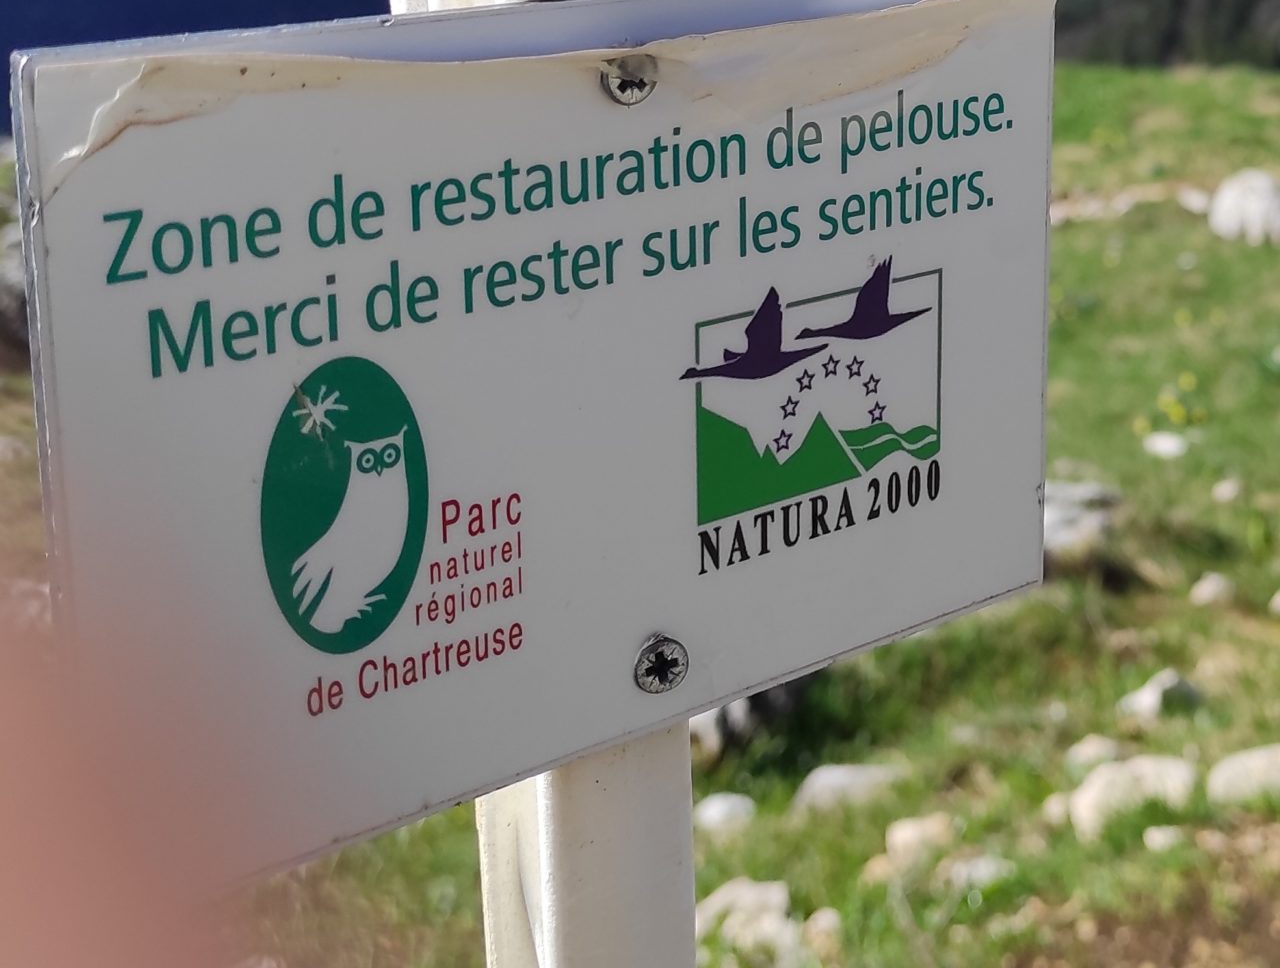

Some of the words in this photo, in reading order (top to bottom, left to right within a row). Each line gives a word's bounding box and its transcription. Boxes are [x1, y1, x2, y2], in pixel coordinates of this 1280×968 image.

[102, 206, 282, 285] Zone
[308, 173, 385, 249] de
[410, 126, 747, 233] restauration
[765, 107, 823, 170] de
[839, 89, 1014, 174] pelouse.
[147, 273, 339, 379] Merci
[365, 259, 439, 334] de
[463, 238, 623, 315] rester
[641, 219, 720, 278] sur
[738, 195, 801, 258] les
[818, 166, 994, 241] sentiers.
[429, 531, 522, 585] naturel
[441, 492, 522, 544] Parc
[697, 486, 856, 576] NATURA
[867, 459, 941, 521] 2000
[415, 566, 522, 626] régional
[307, 676, 344, 716] de
[358, 622, 524, 699] Chartreuse
